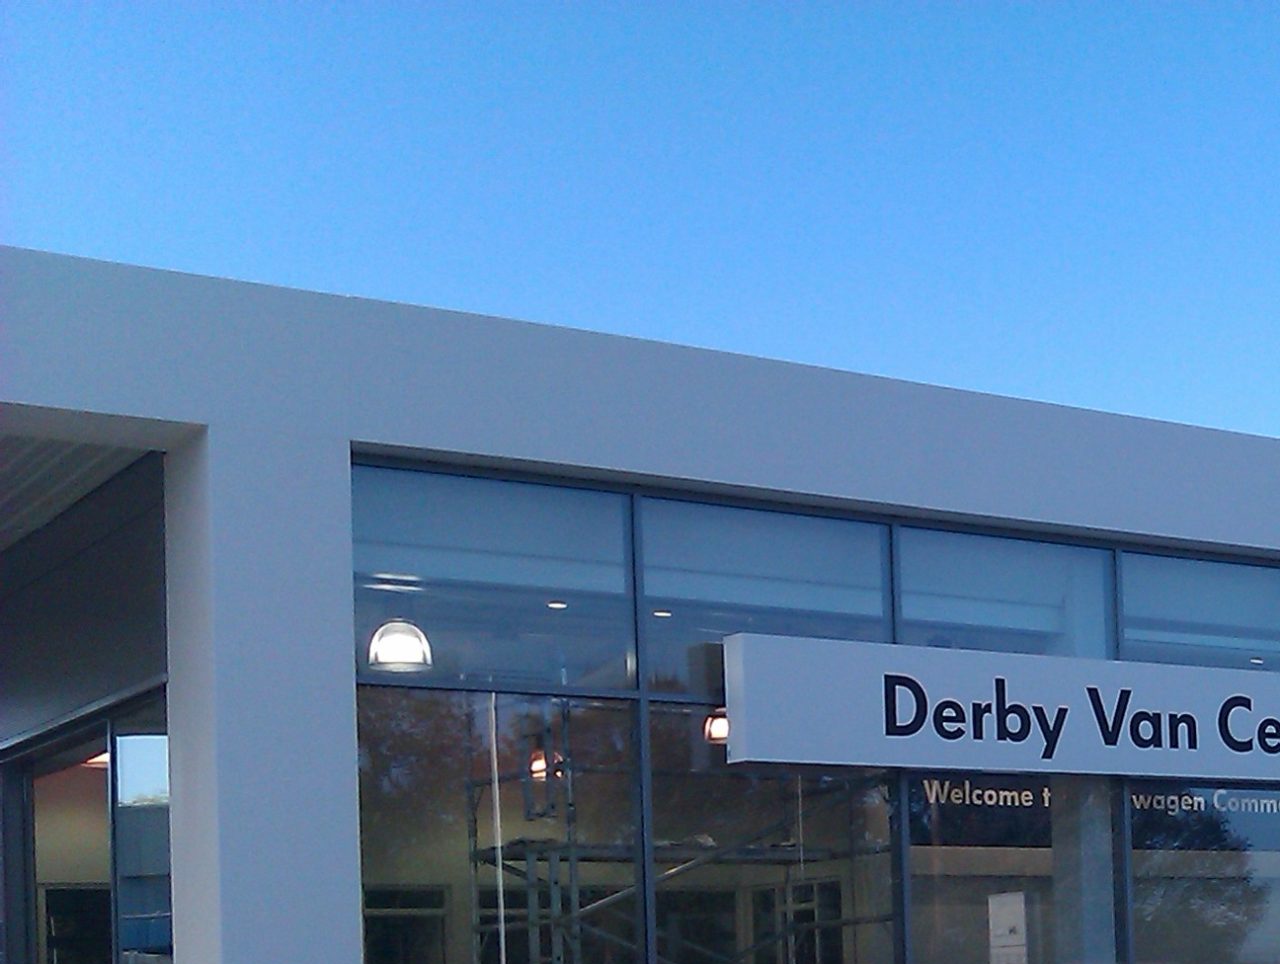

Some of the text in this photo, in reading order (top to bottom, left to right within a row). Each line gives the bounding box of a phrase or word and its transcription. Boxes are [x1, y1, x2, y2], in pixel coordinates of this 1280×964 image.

[883, 673, 1070, 760] Derby
[1085, 686, 1199, 750] Van
[923, 779, 1034, 807] Welcome
[1042, 787, 1051, 808] t
